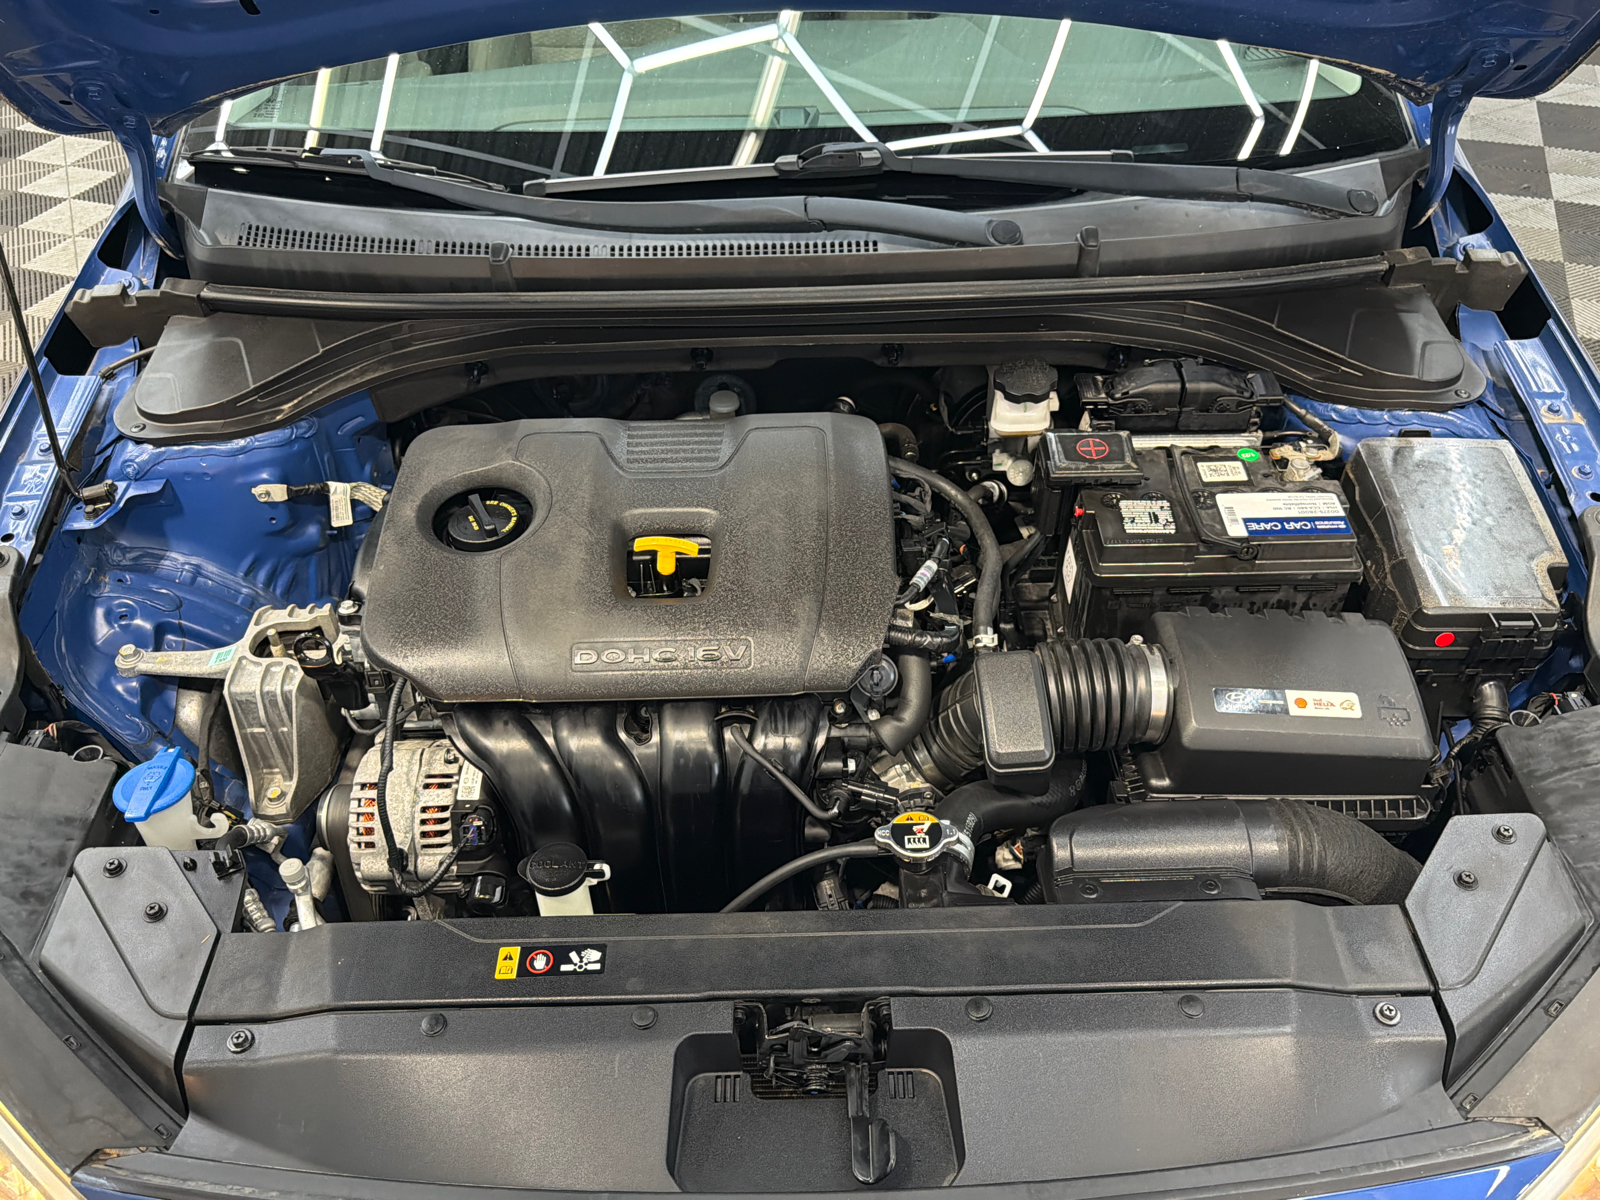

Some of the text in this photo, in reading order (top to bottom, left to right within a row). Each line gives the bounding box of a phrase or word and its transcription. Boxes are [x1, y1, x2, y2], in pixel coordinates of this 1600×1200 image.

[1245, 521, 1311, 531] CAR CARE
[574, 645, 748, 665] DOHC 16V
[878, 829, 890, 837] HCC
